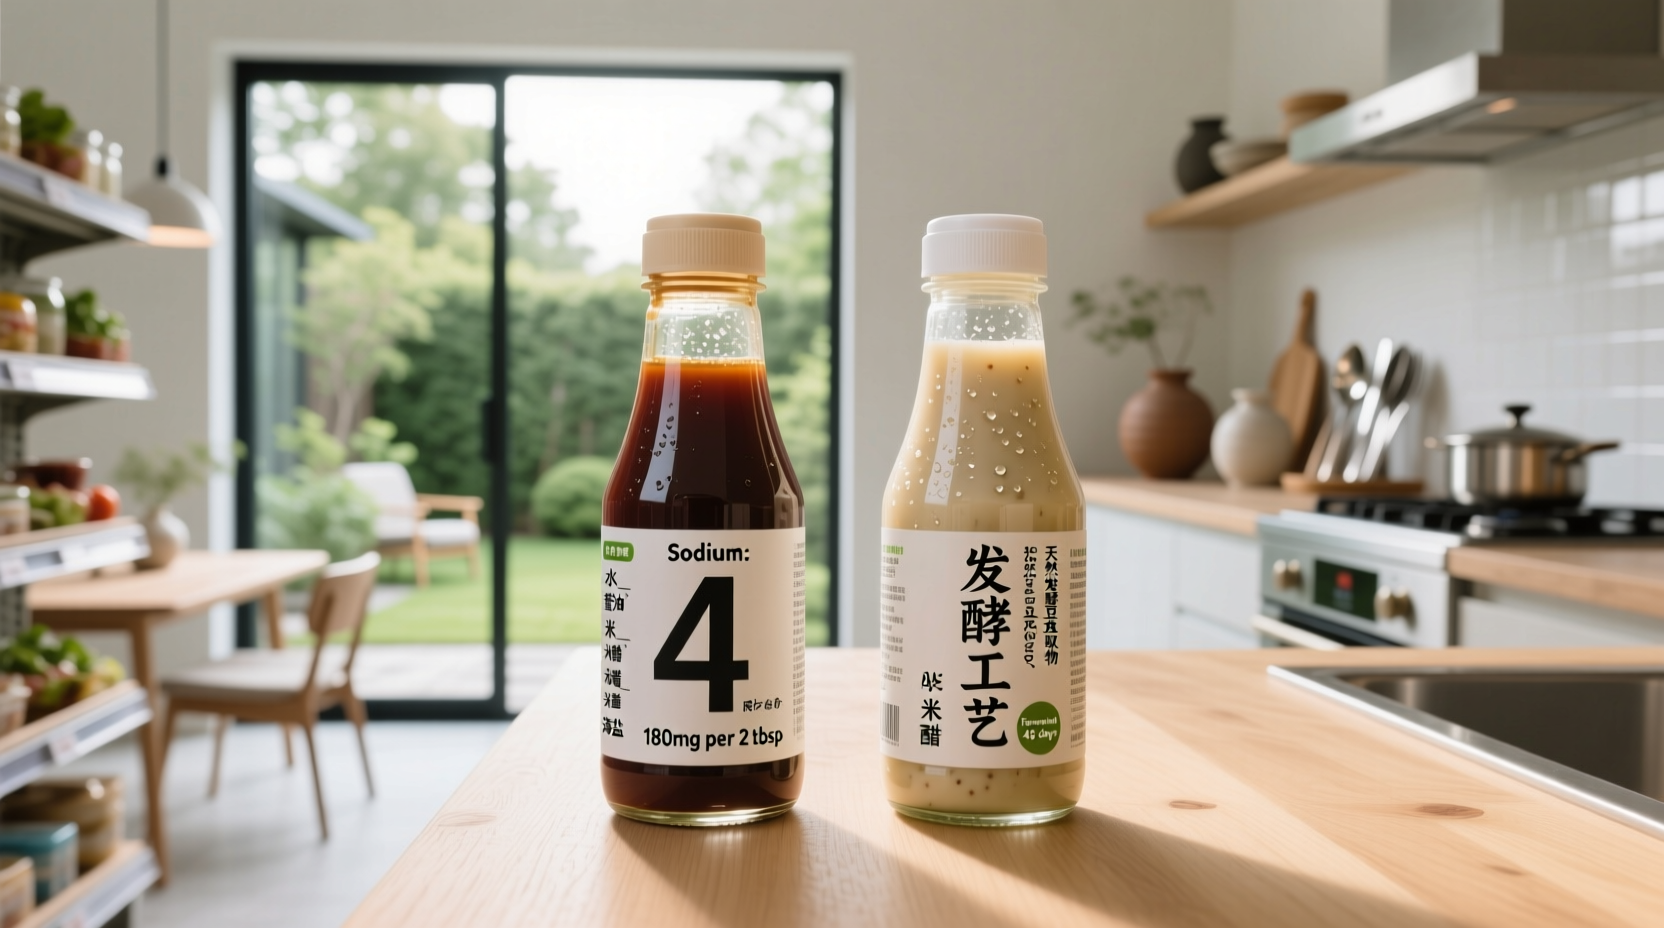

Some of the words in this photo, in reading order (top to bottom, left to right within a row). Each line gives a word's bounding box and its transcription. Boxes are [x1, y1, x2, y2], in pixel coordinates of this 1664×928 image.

[667, 542, 750, 562] Sodium:
[653, 576, 749, 713] 4
[960, 543, 1011, 748] 发酵工艺
[643, 727, 701, 752] 180mg
[705, 732, 735, 752] per
[739, 728, 749, 746] 2
[752, 726, 783, 748] tbsp
